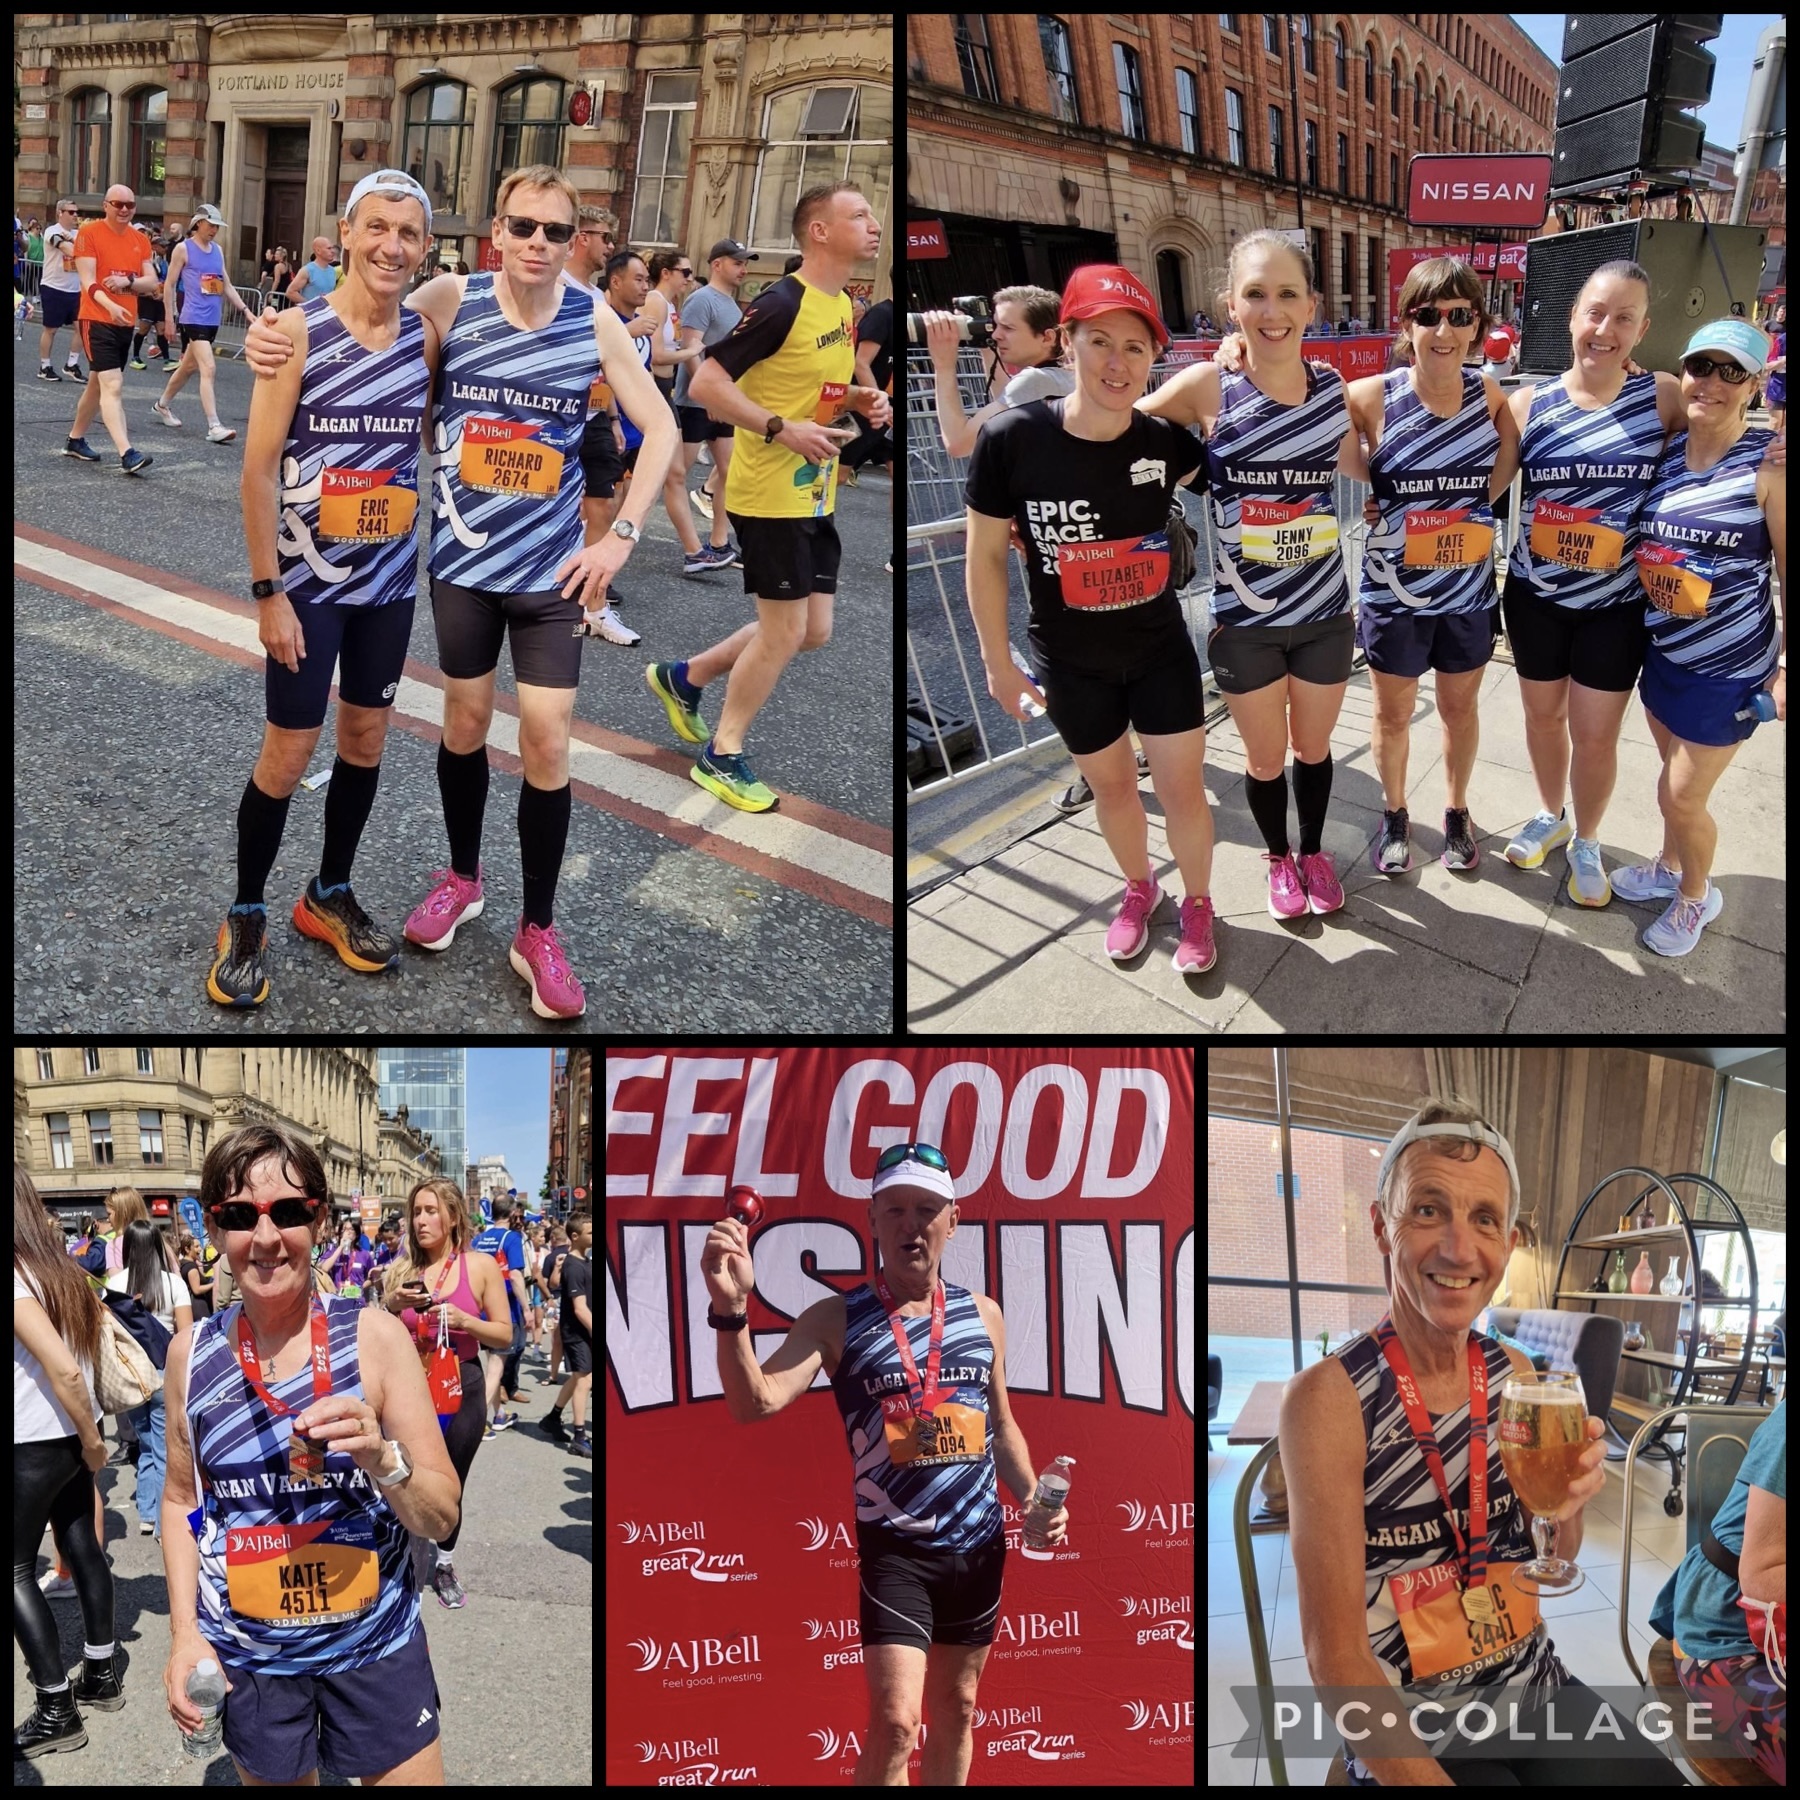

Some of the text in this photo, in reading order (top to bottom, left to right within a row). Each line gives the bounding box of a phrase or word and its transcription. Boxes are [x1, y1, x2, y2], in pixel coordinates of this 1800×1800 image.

[218, 73, 344, 90] PORTLAND HOUSE
[1422, 183, 1534, 200] NISSAN
[907, 235, 939, 246] SAN
[1488, 250, 1518, 268] geat
[1114, 281, 1150, 310] AJBell
[1356, 350, 1379, 367] AJBell
[452, 381, 499, 403] LAGAN
[503, 387, 561, 414] VALLEY
[562, 398, 581, 415] AC
[309, 414, 359, 433] LAGAN
[363, 415, 415, 433] VALLEY
[478, 425, 512, 439] AJBell
[484, 448, 543, 472] RICHARD
[492, 468, 530, 489] 2674
[1225, 466, 1278, 485] LAGAN
[1529, 463, 1655, 482] LAGAN VALLEY AC
[337, 476, 372, 489] AJBell
[472, 483, 523, 497] GOODMOVE
[1392, 476, 1487, 494] LAGAN VALLEY
[360, 499, 390, 517] ERIC
[1025, 500, 1101, 523] EPIC.
[1255, 508, 1289, 520] AJBell
[1546, 508, 1575, 523] AJBell
[356, 518, 389, 536] 3441
[1418, 516, 1448, 527] AJBell
[1029, 523, 1104, 543] RACE.
[1273, 526, 1314, 545] JENNY
[1437, 533, 1465, 549] KATE
[1557, 530, 1595, 550] DAWN
[1657, 521, 1713, 543] VALLEY
[1714, 531, 1743, 547] AC
[1075, 547, 1115, 563] AJBell
[1276, 543, 1309, 560] 2096
[1434, 549, 1463, 564] 4511
[1557, 546, 1589, 565] 4548
[1082, 560, 1155, 588] ELIZABETH
[1099, 581, 1144, 603] 27338
[1081, 600, 1137, 611] GOODMOVE
[823, 1059, 1171, 1200] GOOD
[315, 1344, 328, 1373] 2023
[916, 1366, 978, 1382] VLLEY
[1472, 1365, 1485, 1393] 2023
[1397, 1374, 1420, 1407] 2023
[935, 1416, 953, 1435] AN
[908, 1455, 960, 1468] GOODMOVE
[212, 1477, 257, 1499] AGAN
[1473, 1484, 1483, 1512] AJBell
[1365, 1494, 1511, 1547] LAGAN VALEY
[640, 1521, 706, 1546] AJBell
[243, 1533, 292, 1554] AJBell
[1145, 1539, 1163, 1548] Feel
[642, 1553, 745, 1576] great run
[829, 1558, 849, 1568] Feel
[1055, 1551, 1080, 1561] series
[279, 1562, 328, 1590] KATE
[730, 1571, 758, 1582] series
[1416, 1561, 1462, 1591] AJBel
[279, 1589, 331, 1616] 4511
[1136, 1596, 1191, 1619] AJBell
[342, 1611, 361, 1620] M&S
[994, 1610, 1081, 1647] AJBell
[1136, 1624, 1176, 1646] great
[663, 1635, 761, 1675] AJBell
[823, 1649, 865, 1670] great
[994, 1650, 1012, 1660] Feel
[1042, 1645, 1084, 1656] investing.
[1440, 1646, 1517, 1682] GOODMOVE
[663, 1678, 684, 1688] Feel
[718, 1671, 765, 1684] investing.
[986, 1705, 1042, 1730] AJBell
[657, 1737, 720, 1763] AJBell
[987, 1734, 1075, 1757] great run
[1148, 1736, 1167, 1746] Feel
[1061, 1750, 1086, 1761] series
[658, 1766, 757, 1786] great run
[839, 1766, 856, 1776] Fee
